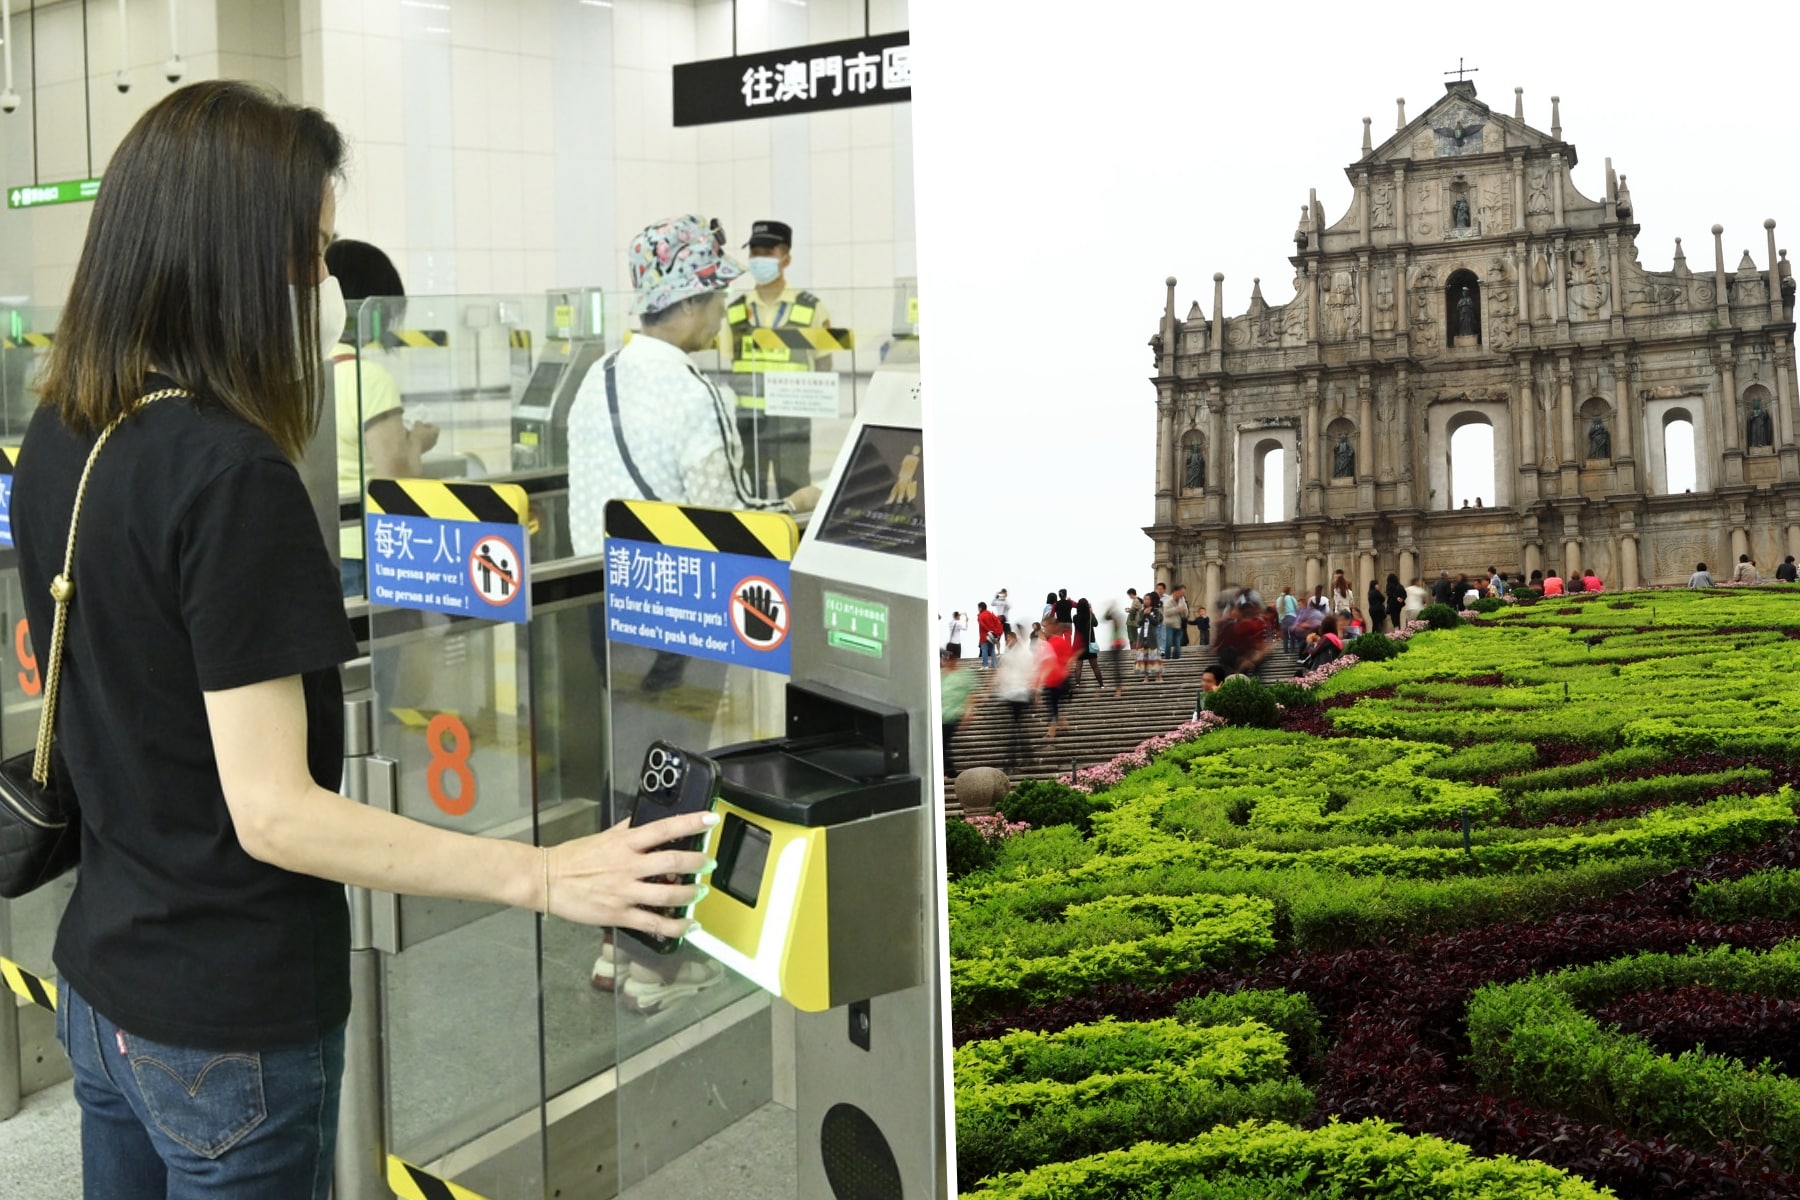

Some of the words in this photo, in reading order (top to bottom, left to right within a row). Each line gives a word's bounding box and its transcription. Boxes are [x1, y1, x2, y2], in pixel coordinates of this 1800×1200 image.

[741, 45, 911, 107] 往澳門市區
[374, 519, 461, 563] 每次一人!
[375, 563, 395, 577] Uma
[425, 571, 441, 584] por
[375, 585, 394, 599] One
[395, 590, 423, 603] person
[425, 593, 434, 604] at
[435, 595, 441, 605] a
[442, 593, 462, 608] time
[625, 595, 642, 612] favor
[643, 599, 650, 614] de
[665, 606, 697, 622] empurrar
[698, 611, 702, 623] a
[703, 612, 722, 628] porta
[611, 618, 637, 635] Please
[664, 630, 686, 645] push
[688, 632, 704, 648] the
[705, 635, 729, 652] door
[426, 713, 476, 817] 8
